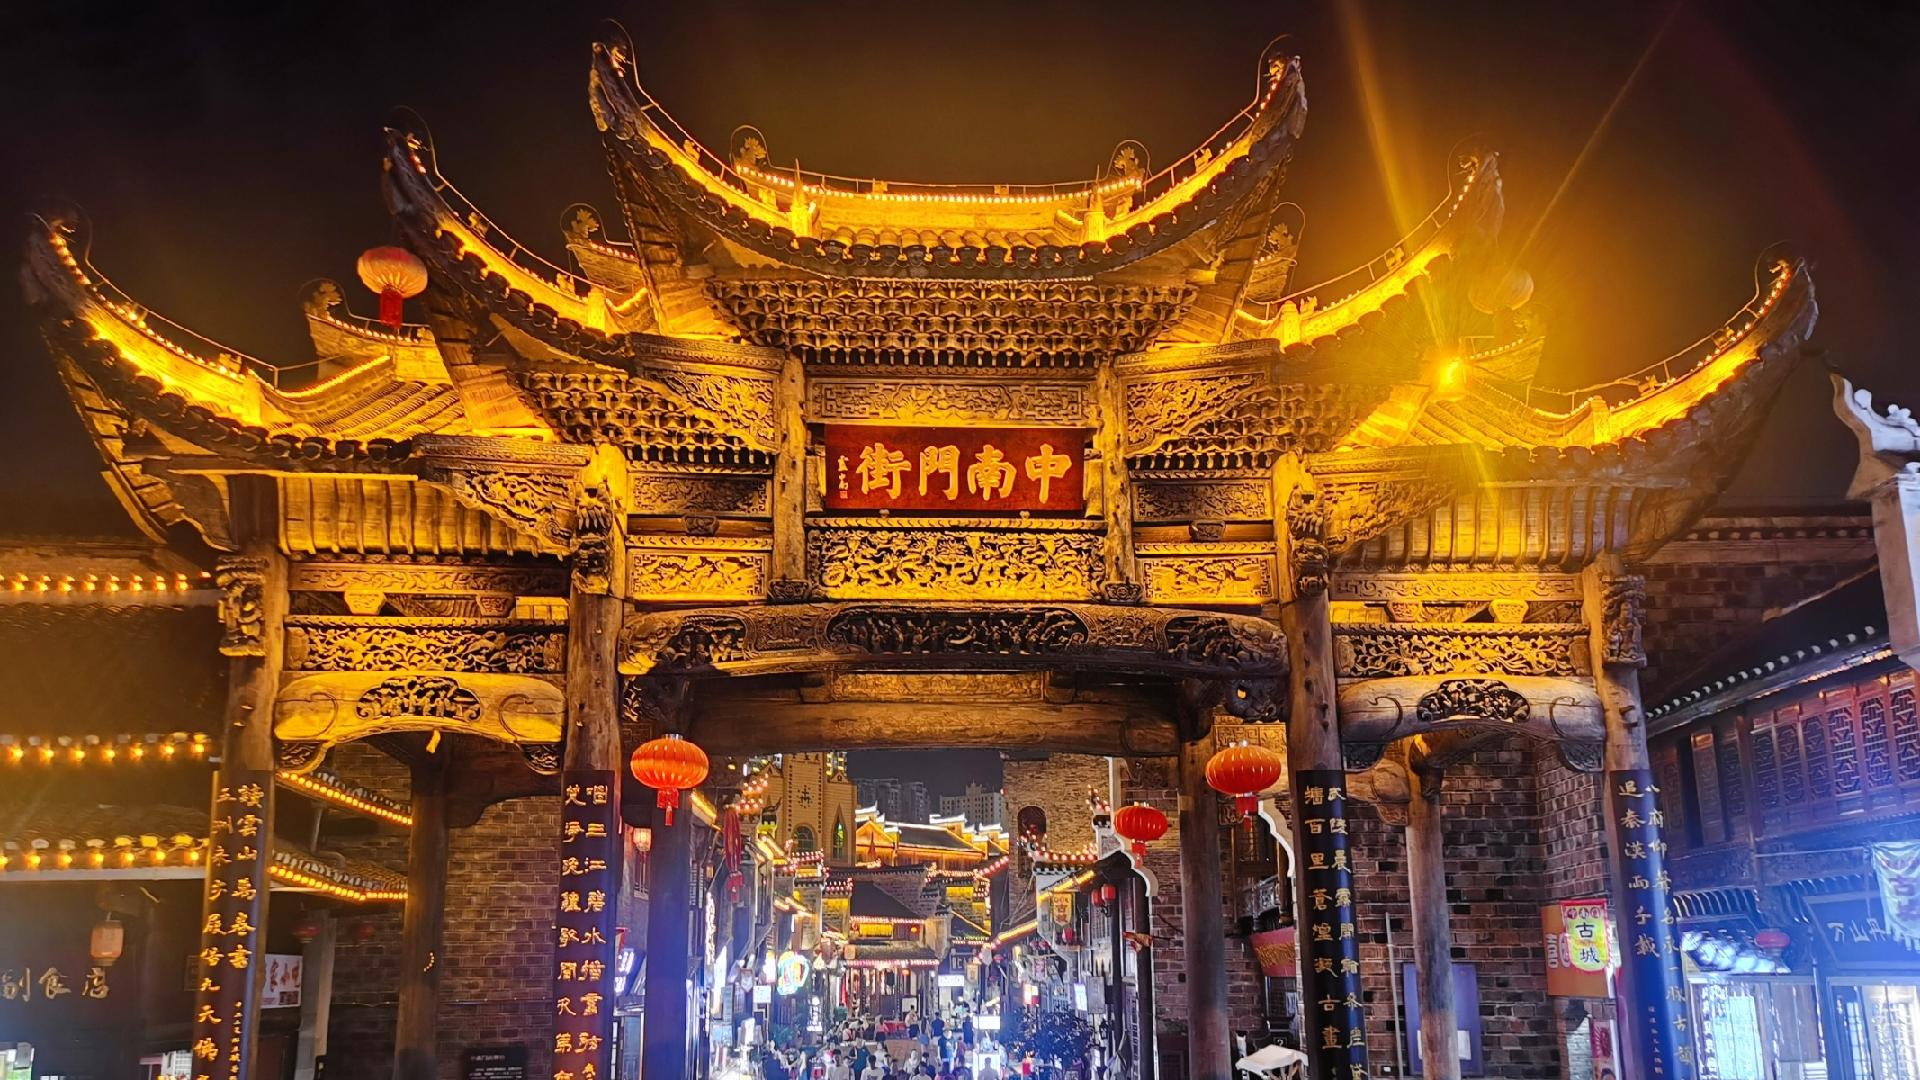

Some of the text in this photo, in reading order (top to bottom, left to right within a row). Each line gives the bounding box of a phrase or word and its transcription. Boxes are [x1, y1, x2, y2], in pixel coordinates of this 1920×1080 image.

[856, 443, 1072, 503] 中南門街
[1576, 922, 1600, 963] 古城
[1, 967, 110, 1001] 副食店
